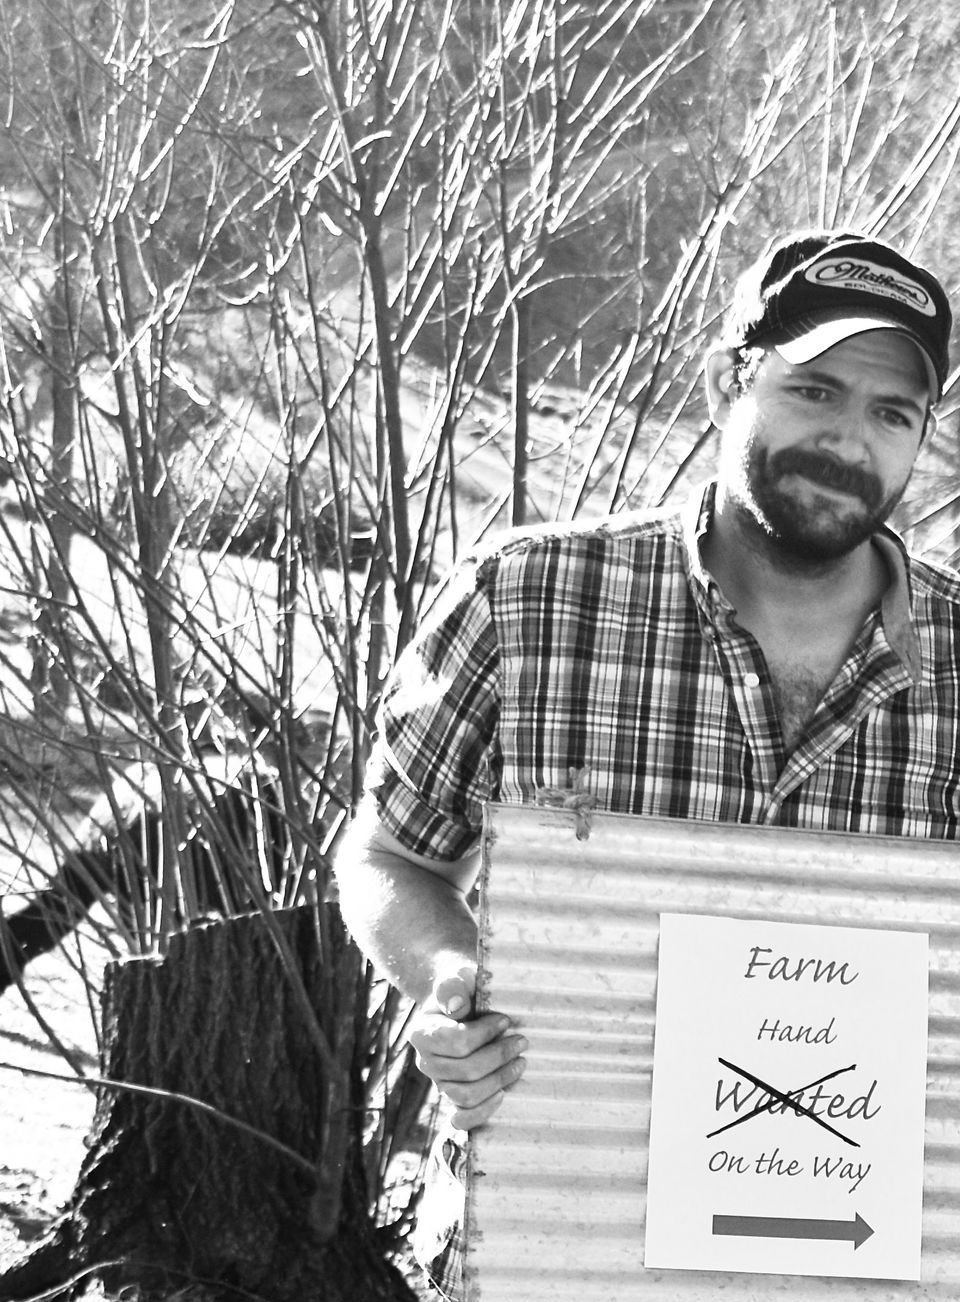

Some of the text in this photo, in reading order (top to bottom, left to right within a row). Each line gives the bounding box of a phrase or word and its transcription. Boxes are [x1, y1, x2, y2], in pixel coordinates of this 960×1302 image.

[744, 946, 859, 985] Farm
[757, 1017, 838, 1044] Hand
[714, 1080, 882, 1120] Wanted
[709, 1148, 872, 1193] On the Way
